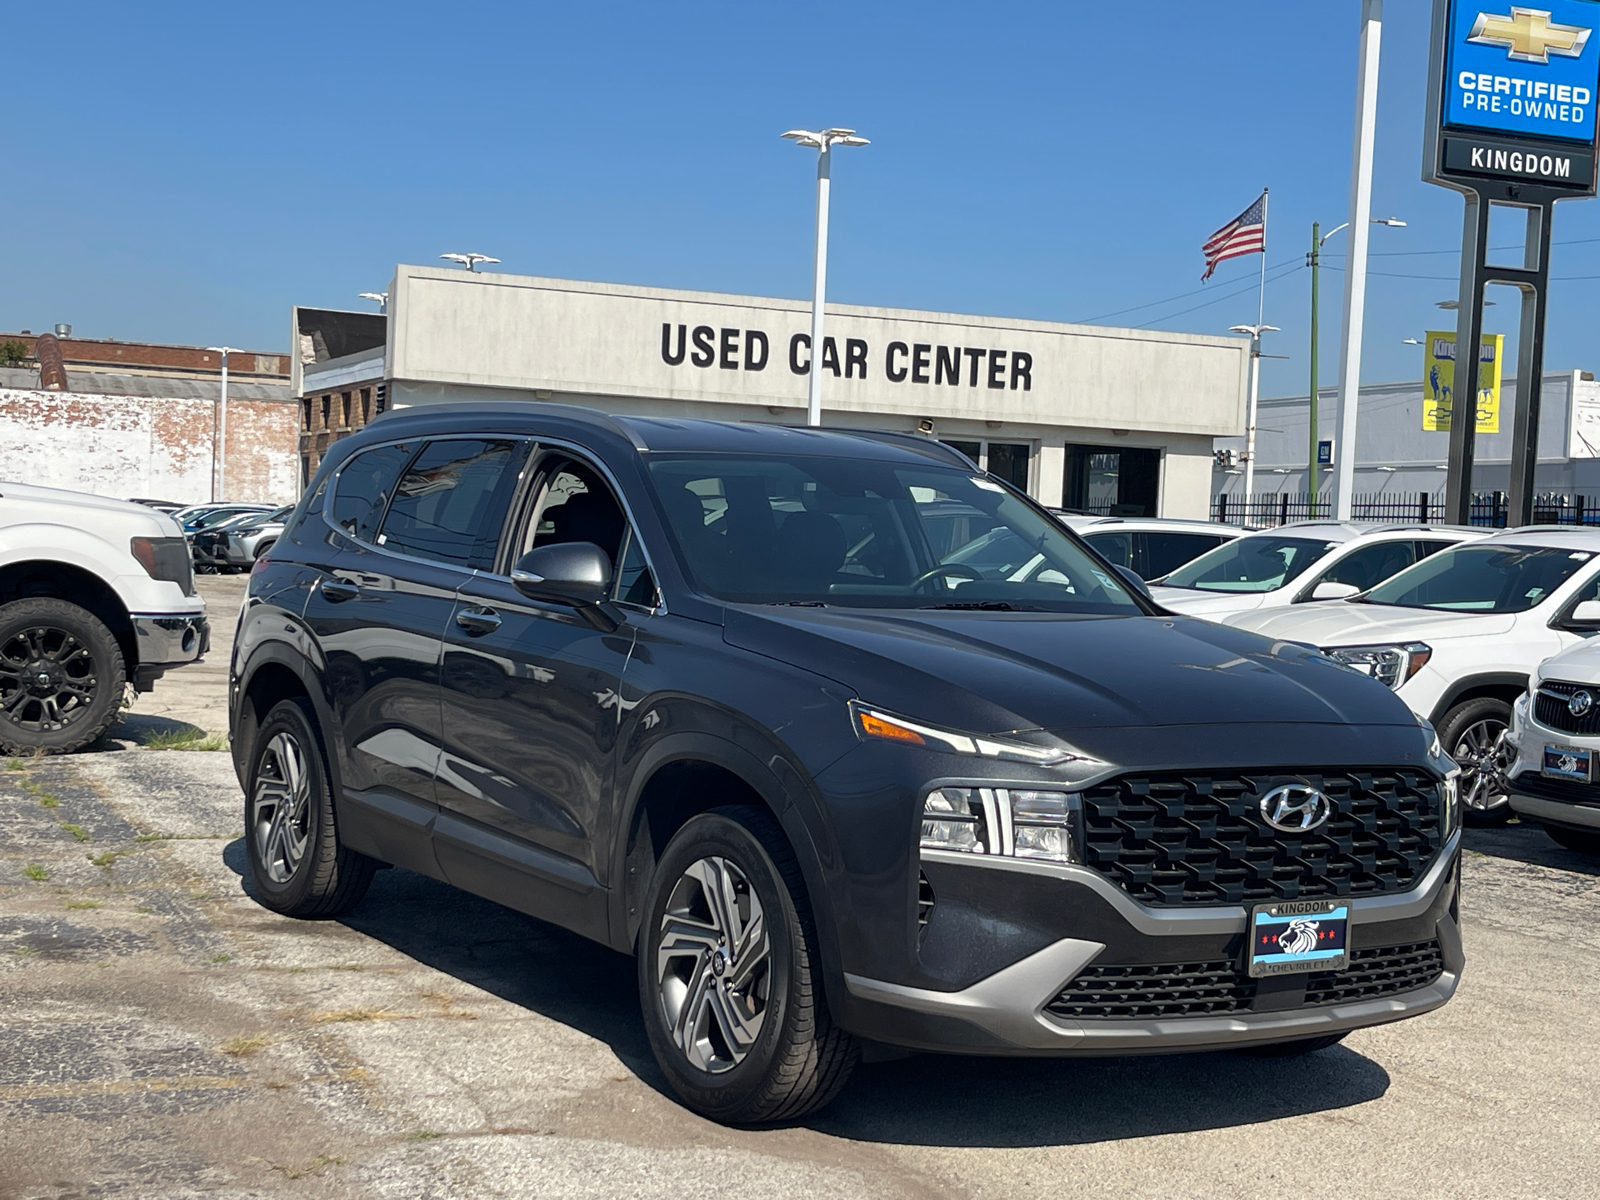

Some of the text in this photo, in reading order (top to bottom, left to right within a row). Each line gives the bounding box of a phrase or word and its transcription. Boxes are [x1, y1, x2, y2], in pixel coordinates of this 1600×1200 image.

[1458, 71, 1591, 105] CERTIFIED
[1462, 92, 1584, 123] PRE-OWNED
[1471, 147, 1570, 178] KINGDOM
[661, 322, 1034, 391] USED CAR CENTER
[1276, 901, 1329, 915] KINGDOM
[1271, 960, 1326, 973] CHEVROLET
